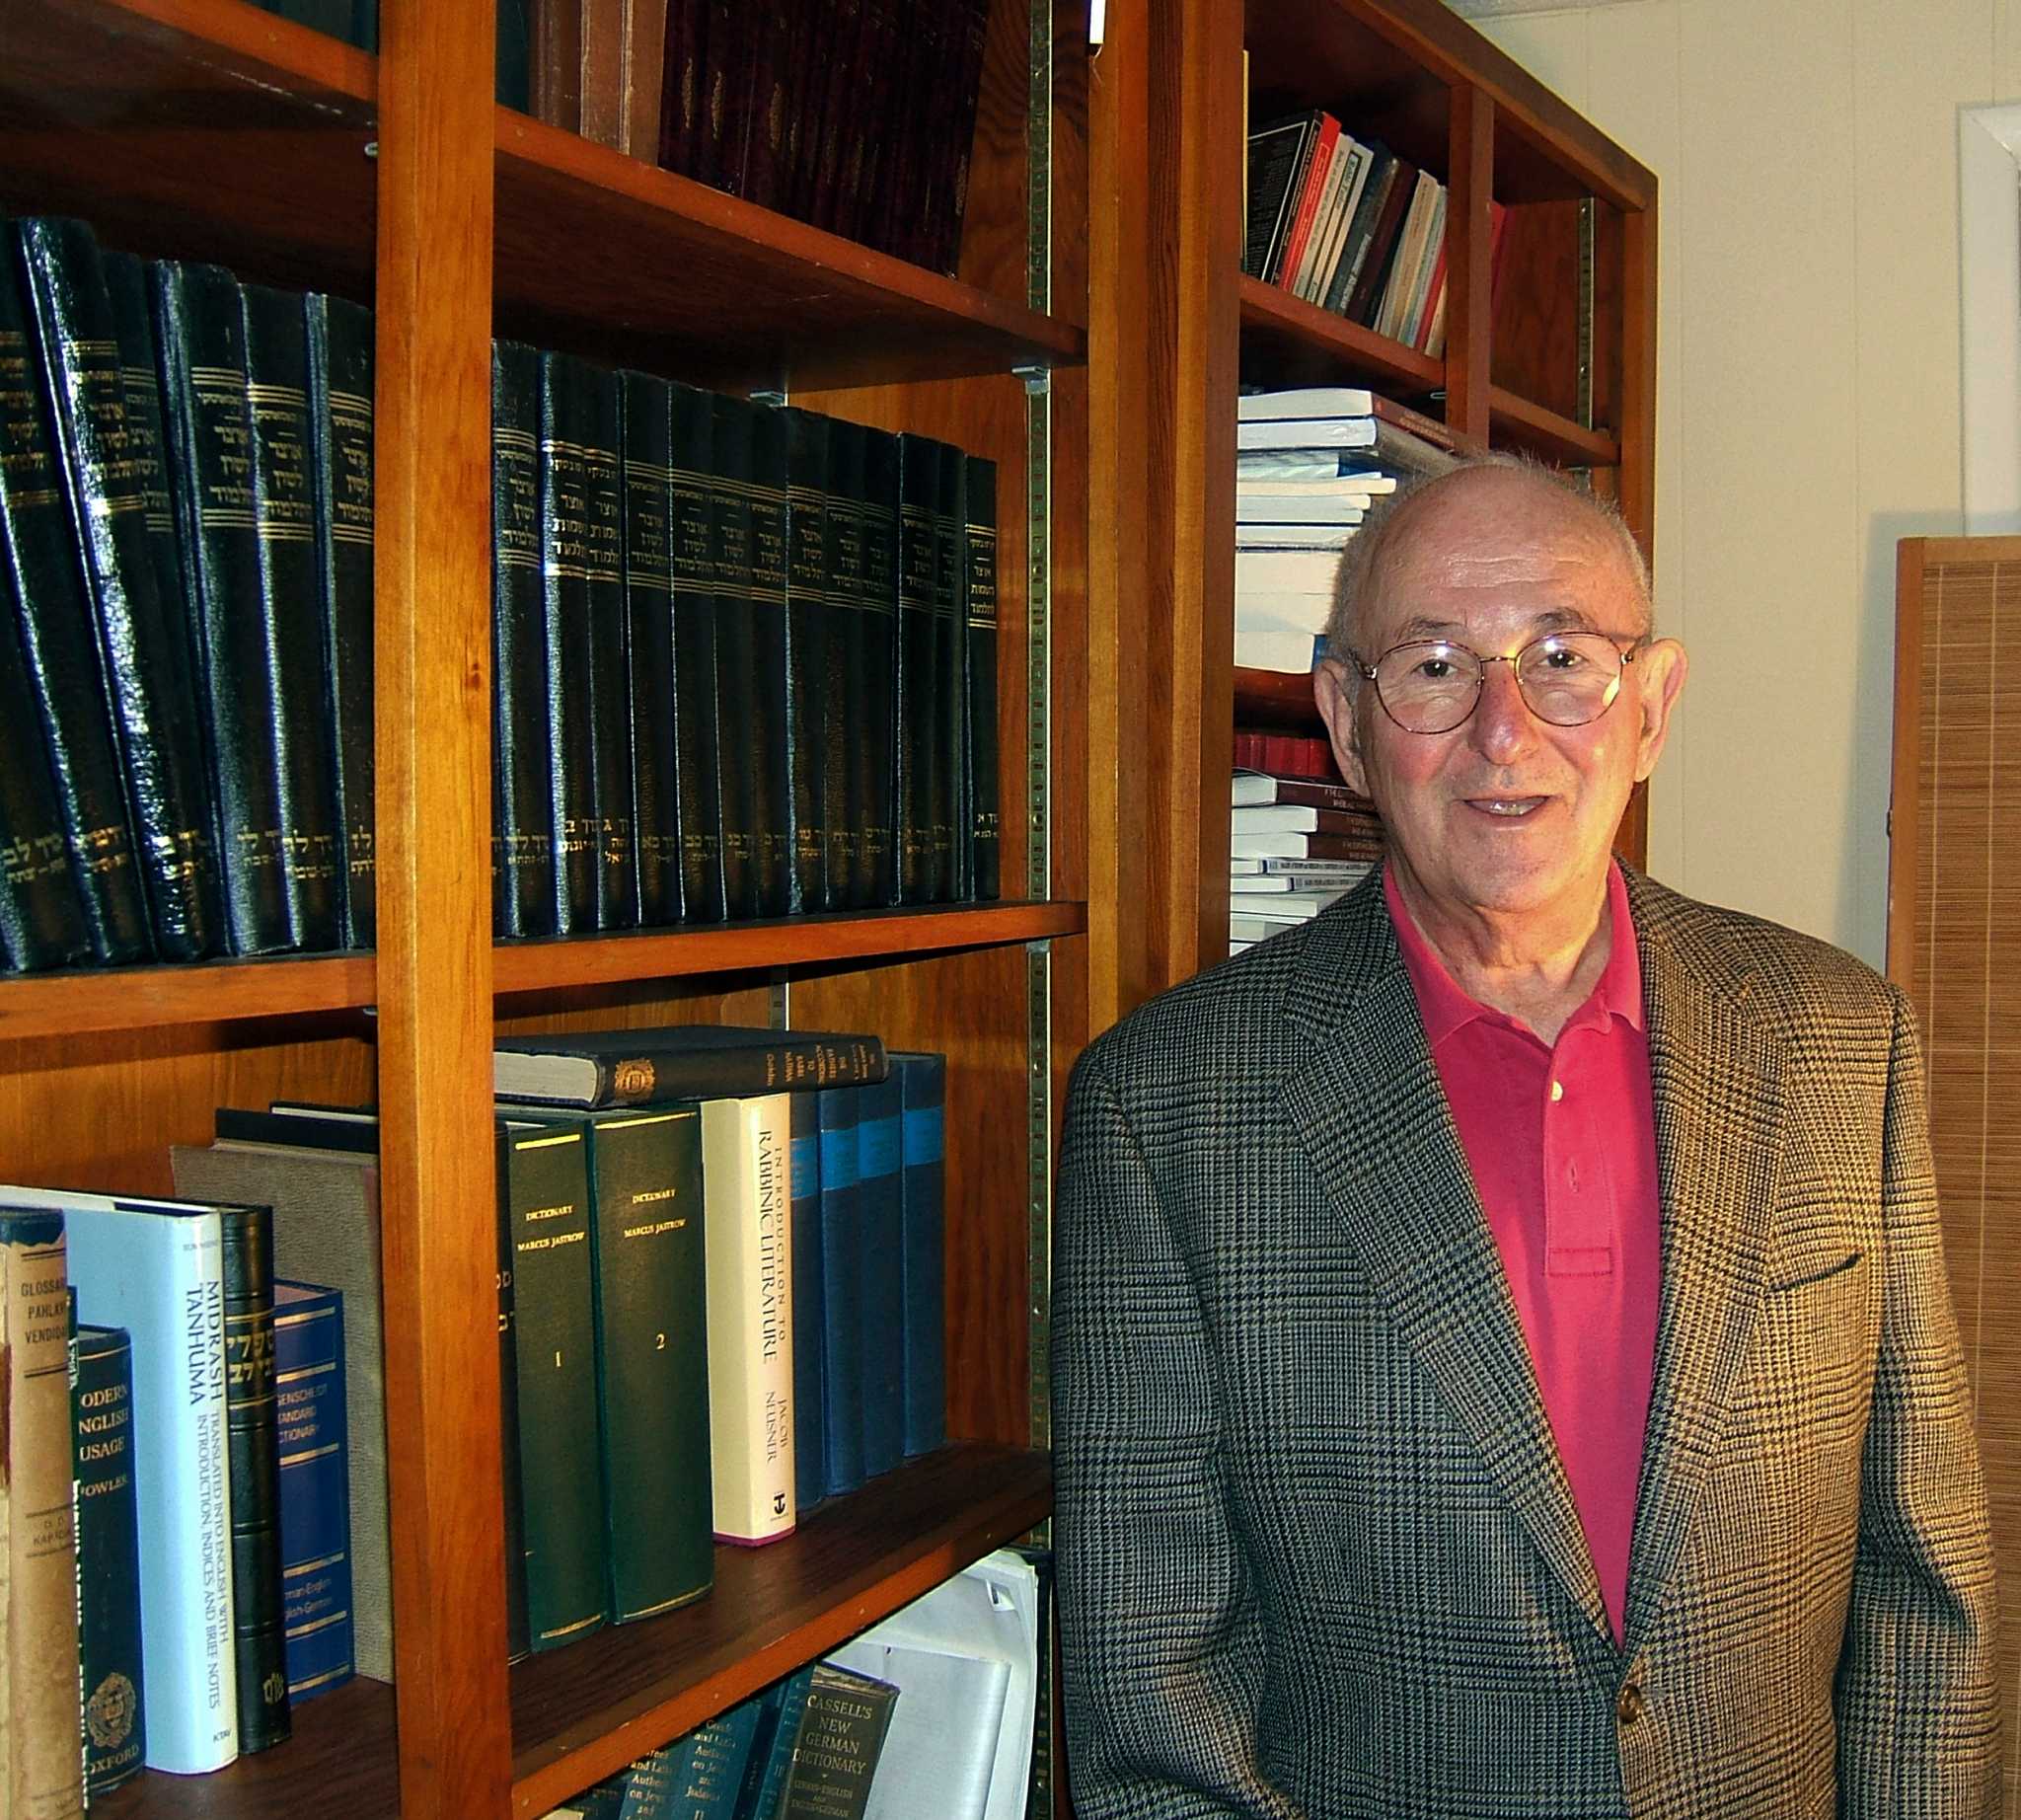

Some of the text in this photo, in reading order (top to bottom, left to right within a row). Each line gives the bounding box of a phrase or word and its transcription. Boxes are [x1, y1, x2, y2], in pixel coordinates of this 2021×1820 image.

[632, 1188, 676, 1204] DICTIONARY
[525, 1204, 574, 1222] DICTIONARY
[517, 1231, 585, 1251] MARCUS JASTROW
[624, 1224, 654, 1239] MARCUS
[775, 1147, 786, 1340] INTRODUCTION TO
[759, 1130, 778, 1364] RABBINIC LITERATURE
[187, 1283, 206, 1405] TANHUMA
[207, 1281, 223, 1402] MIDRASH
[655, 1333, 666, 1351] 2
[80, 1384, 127, 1408] ODERN
[79, 1406, 129, 1435] NGLISH
[766, 1391, 778, 1464] NEUSNER
[778, 1399, 788, 1448] JACOB
[79, 1436, 125, 1461] USAGE
[211, 1412, 229, 1643] TRANSLATED INTO ENGLISH WITH
[201, 1531, 214, 1587] INDICES
[204, 1590, 216, 1622] AND
[206, 1624, 218, 1660] BRIEF
[207, 1663, 220, 1709] NOTES
[807, 1695, 873, 1719] CASSELL'S
[819, 1716, 852, 1734] NEW
[805, 1732, 861, 1754] GERMAN
[792, 1748, 866, 1775] DICTIONARY
